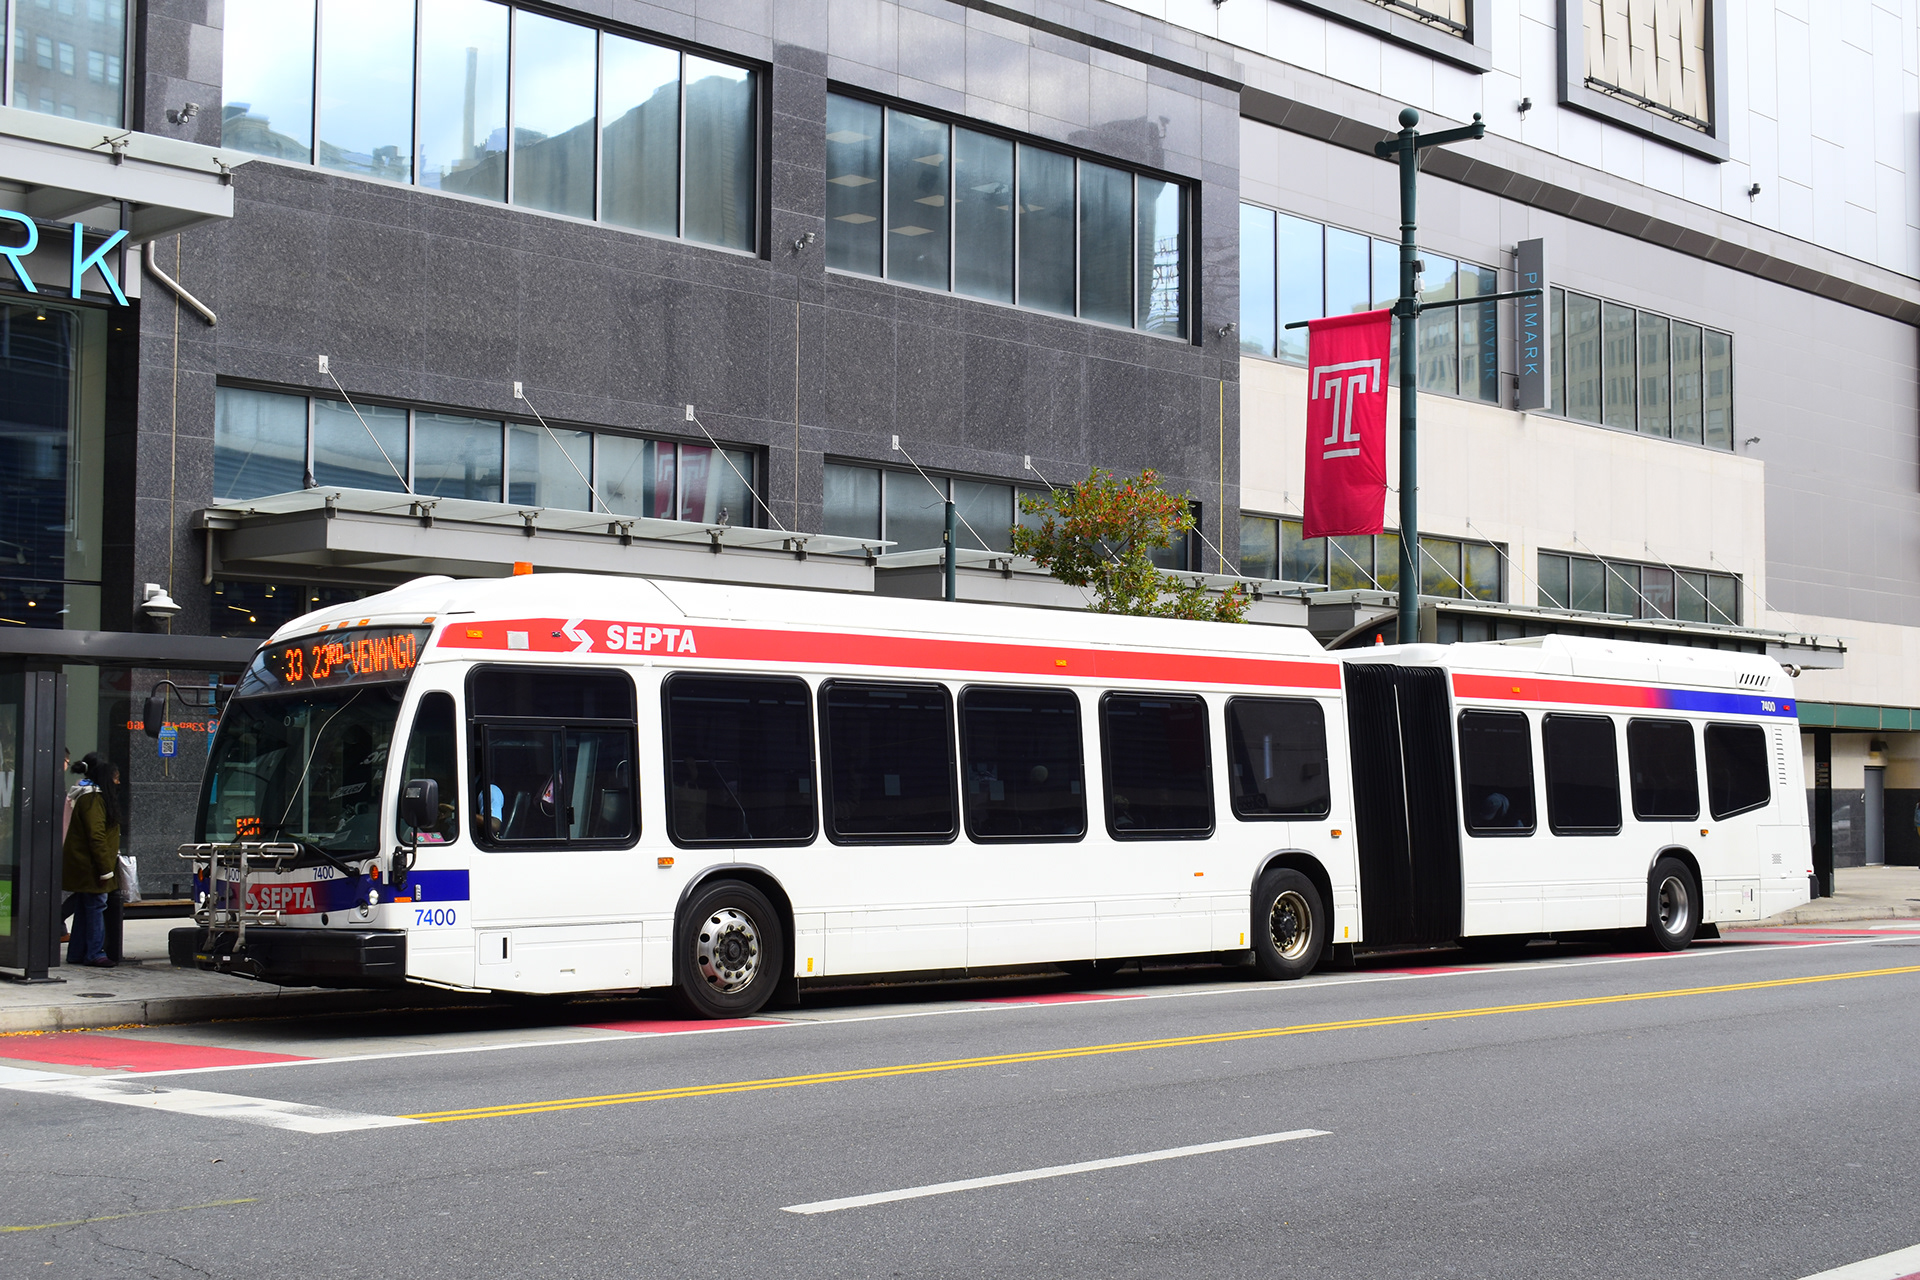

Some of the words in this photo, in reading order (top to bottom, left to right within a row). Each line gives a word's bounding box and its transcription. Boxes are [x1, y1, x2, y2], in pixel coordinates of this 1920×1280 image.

[1312, 358, 1382, 460] T
[605, 623, 697, 654] SEPTA
[285, 648, 303, 682] 33
[312, 633, 416, 679] 23RD-VENANGO
[1760, 700, 1776, 713] 7400
[313, 865, 334, 880] 7400
[260, 886, 315, 909] SEPTA
[414, 908, 456, 926] 7400
